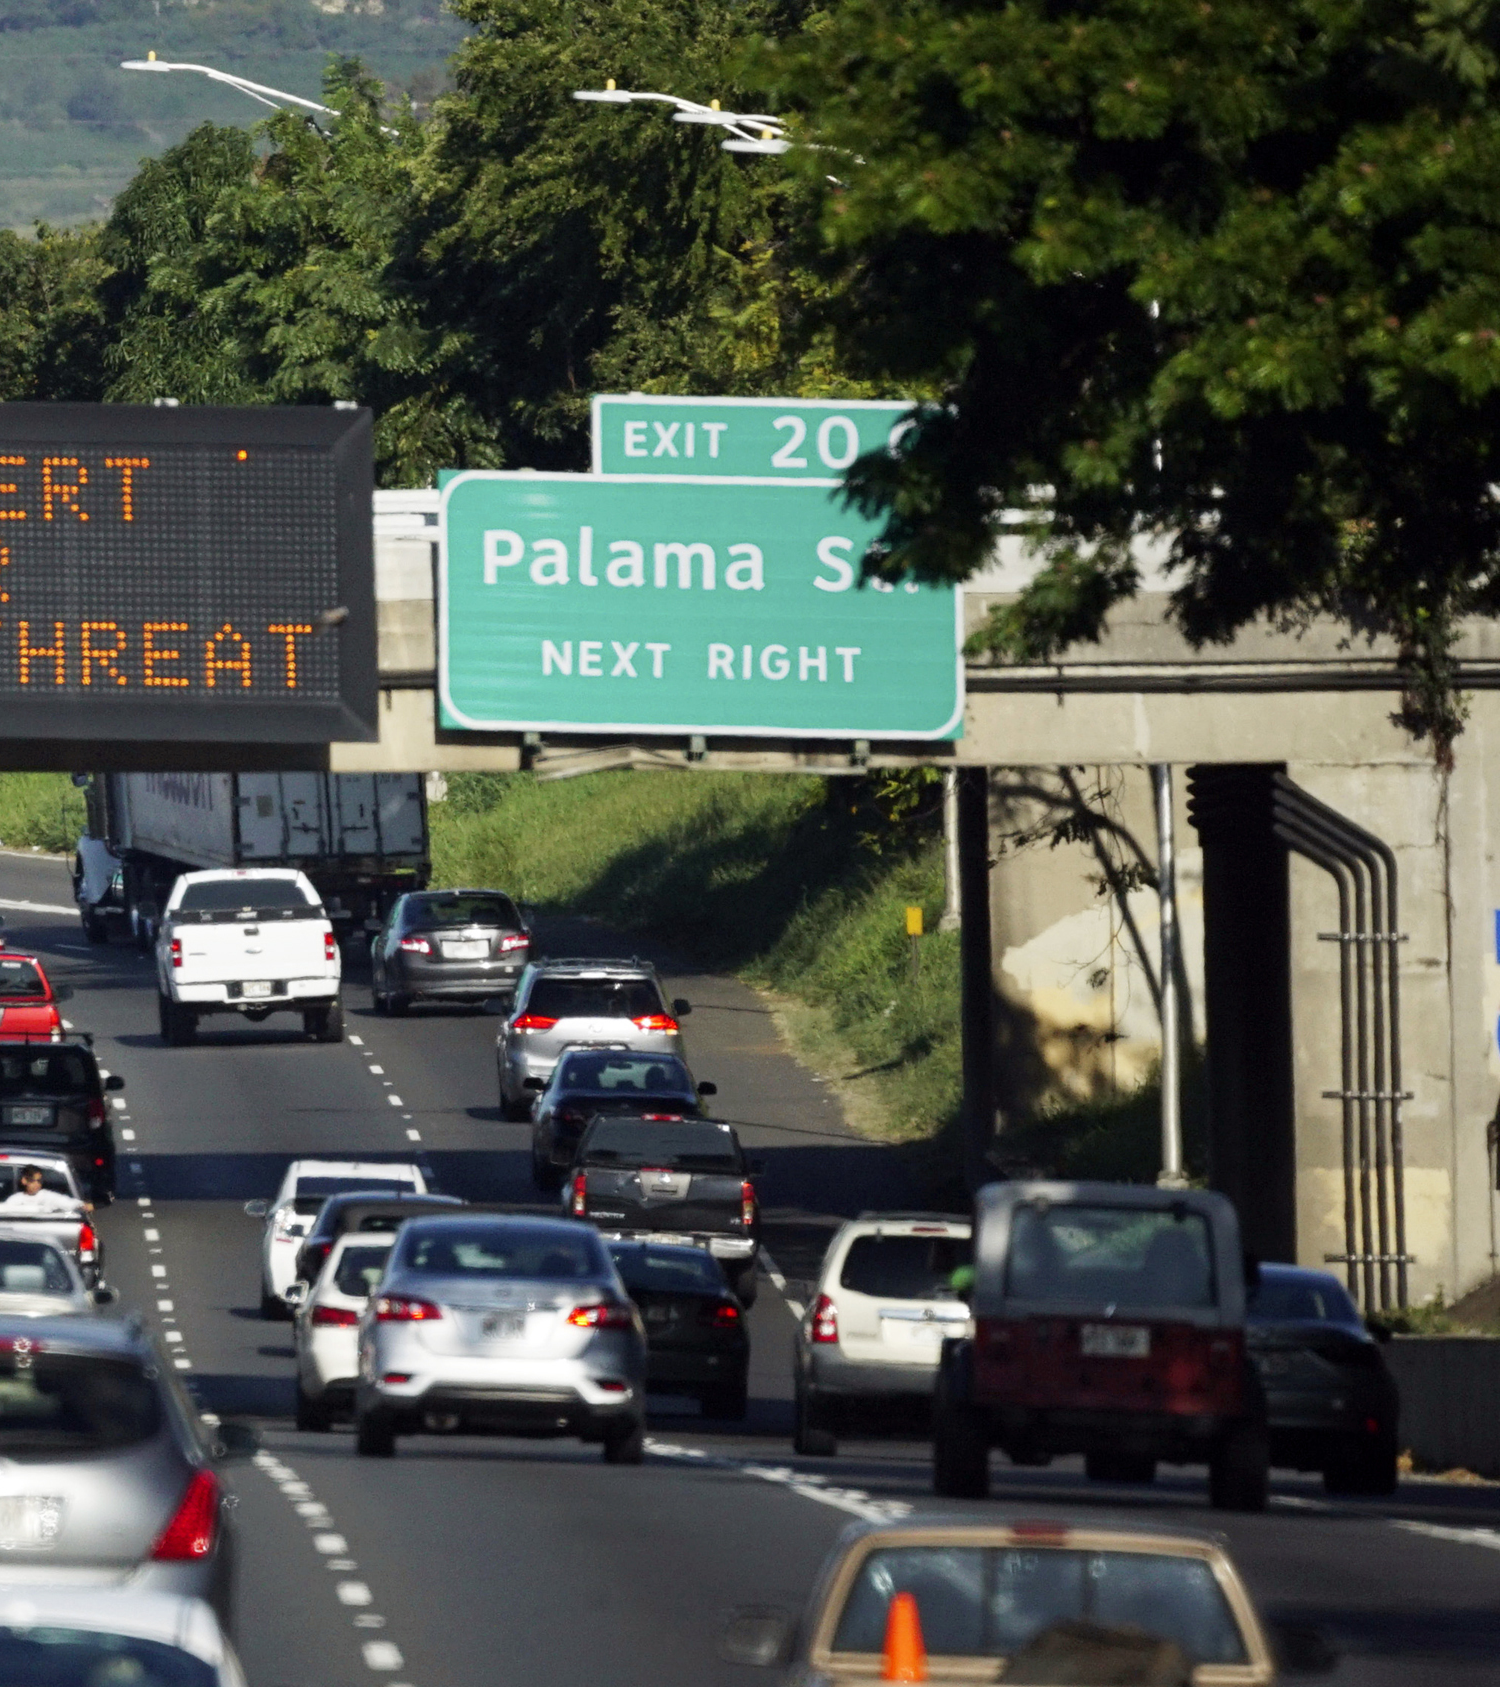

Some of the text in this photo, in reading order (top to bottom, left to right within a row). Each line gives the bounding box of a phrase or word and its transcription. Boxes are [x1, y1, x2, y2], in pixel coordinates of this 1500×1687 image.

[623, 419, 729, 458] EXIT
[770, 415, 860, 470] 20
[482, 524, 766, 591] Palama
[540, 639, 862, 684] NEXT RIGHT
